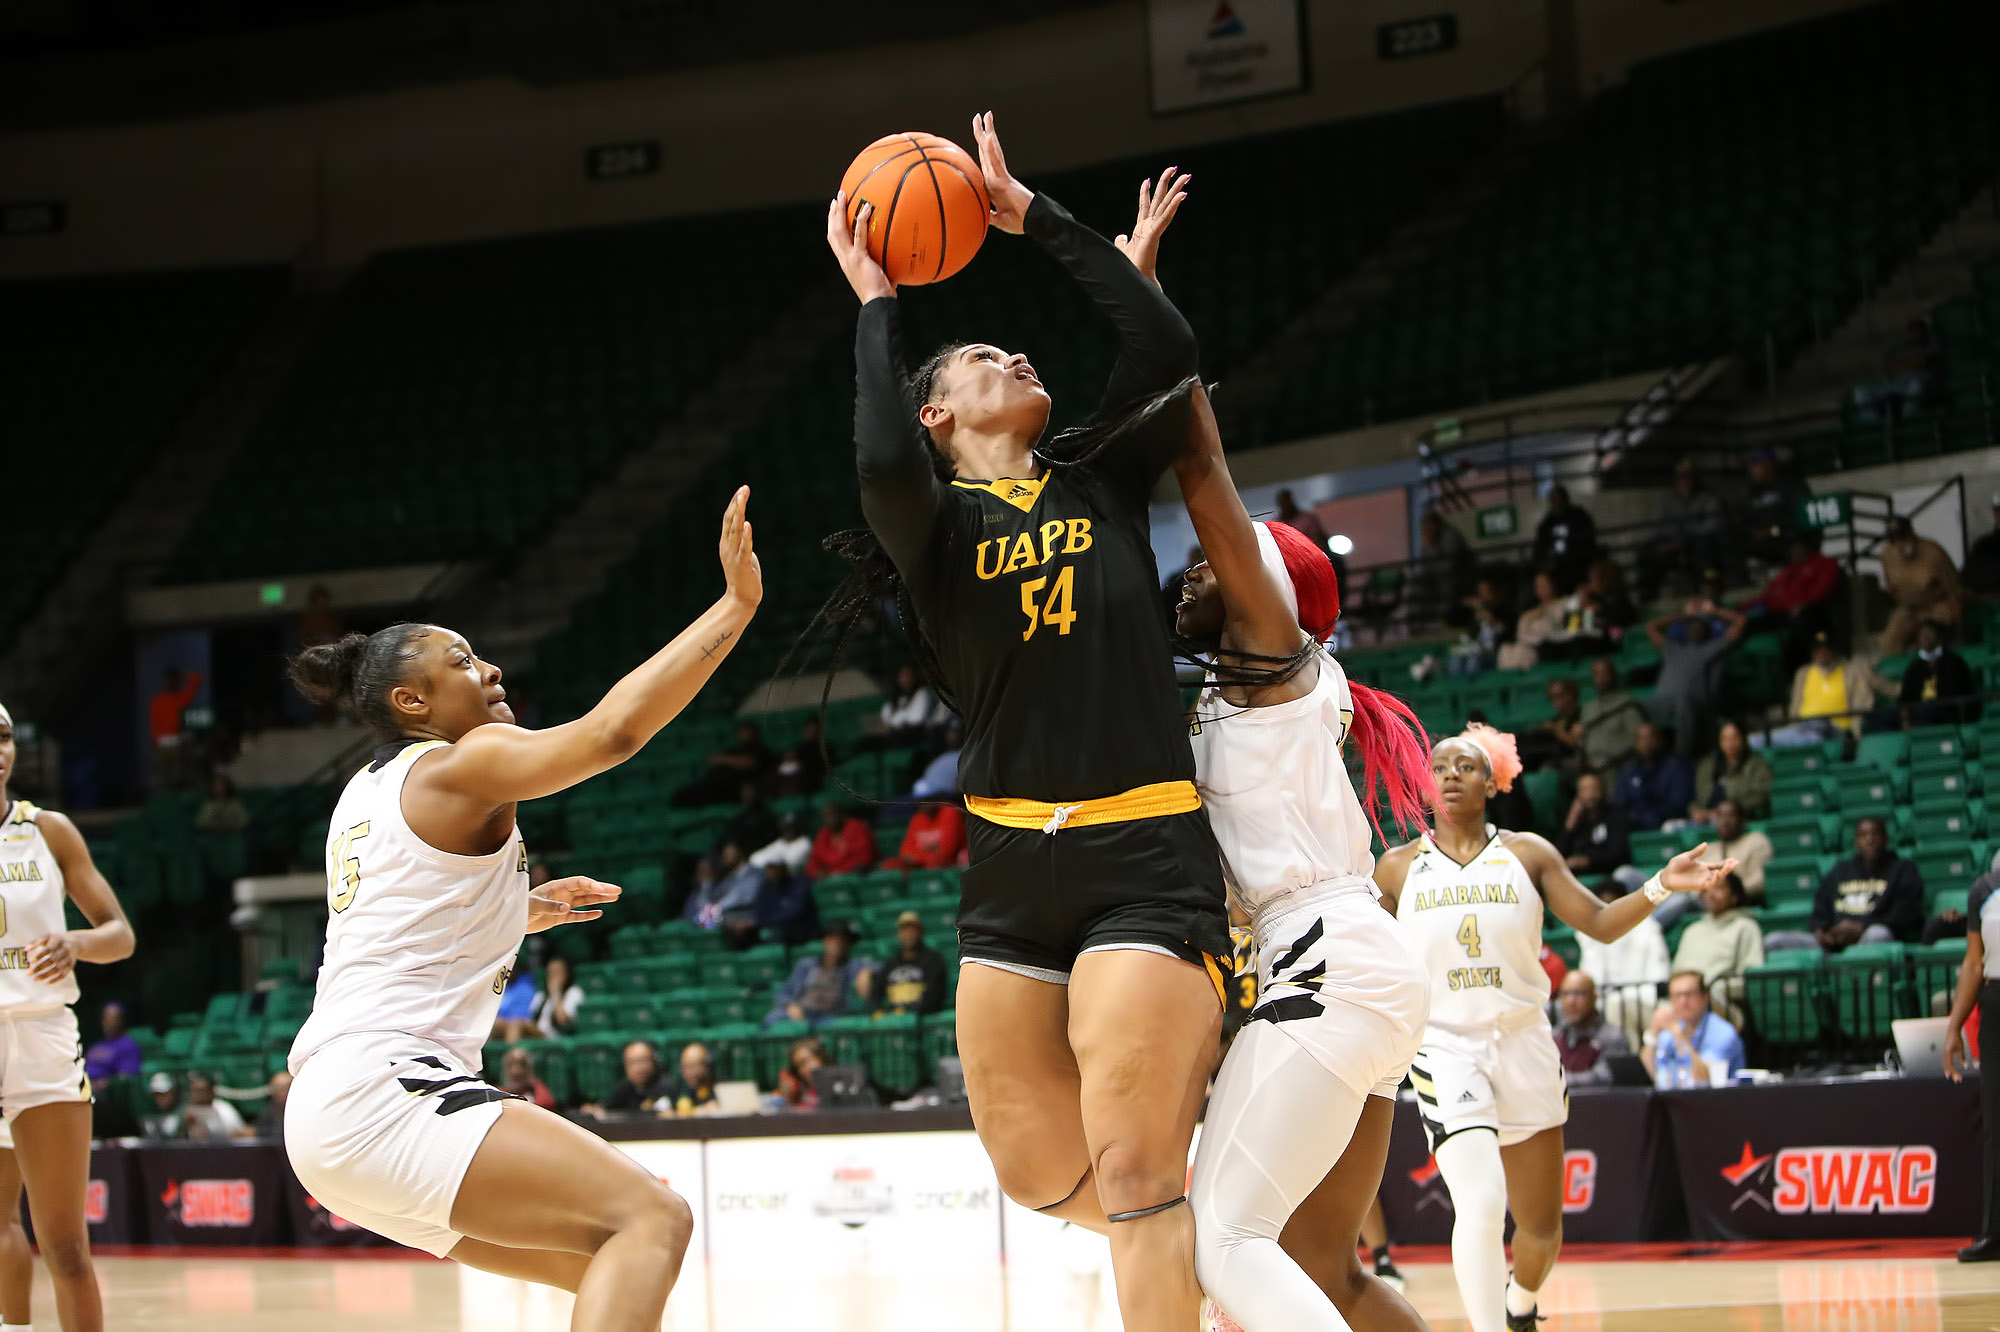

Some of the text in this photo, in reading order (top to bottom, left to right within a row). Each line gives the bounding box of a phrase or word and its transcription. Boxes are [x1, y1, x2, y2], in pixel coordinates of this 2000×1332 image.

[976, 518, 1093, 580] UAPB
[1020, 565, 1077, 642] 54
[1415, 884, 1519, 912] ALABAMA
[1456, 913, 1481, 958] 4
[1447, 966, 1503, 992] STATE
[1773, 1145, 1938, 1215] SWAC
